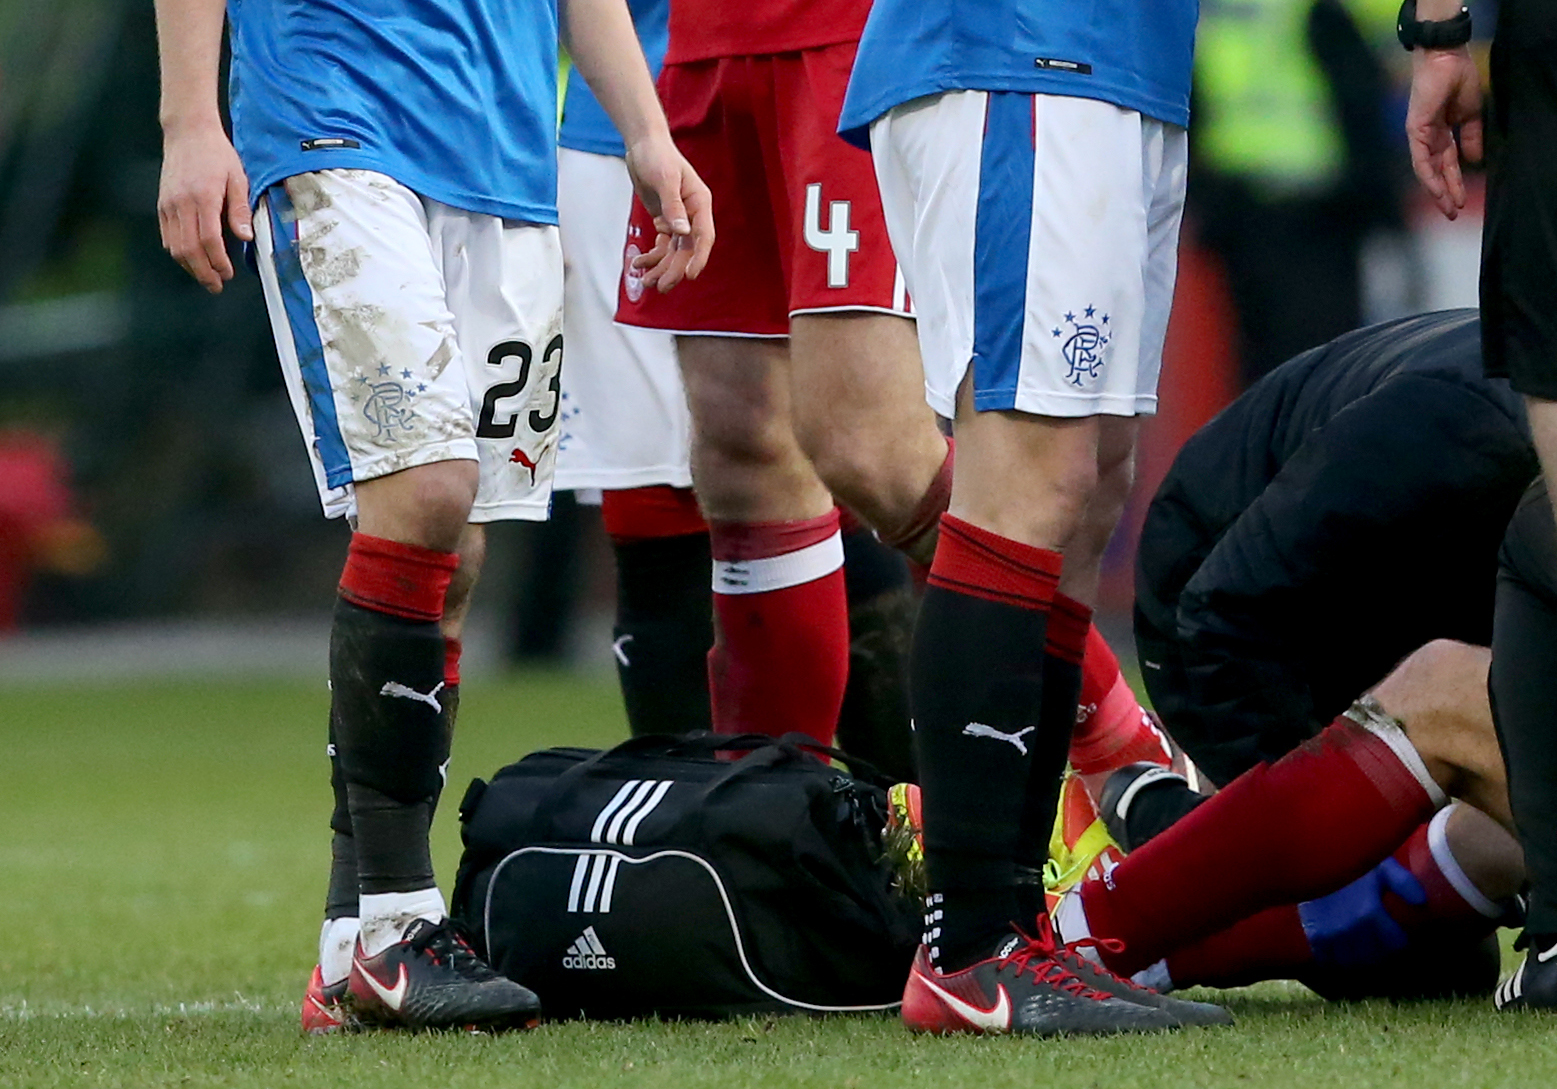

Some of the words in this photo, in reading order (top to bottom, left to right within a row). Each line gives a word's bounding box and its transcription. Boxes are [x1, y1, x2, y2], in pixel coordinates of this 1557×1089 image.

[803, 181, 860, 289] 4
[475, 333, 564, 439] 23
[562, 954, 616, 970] adidas
